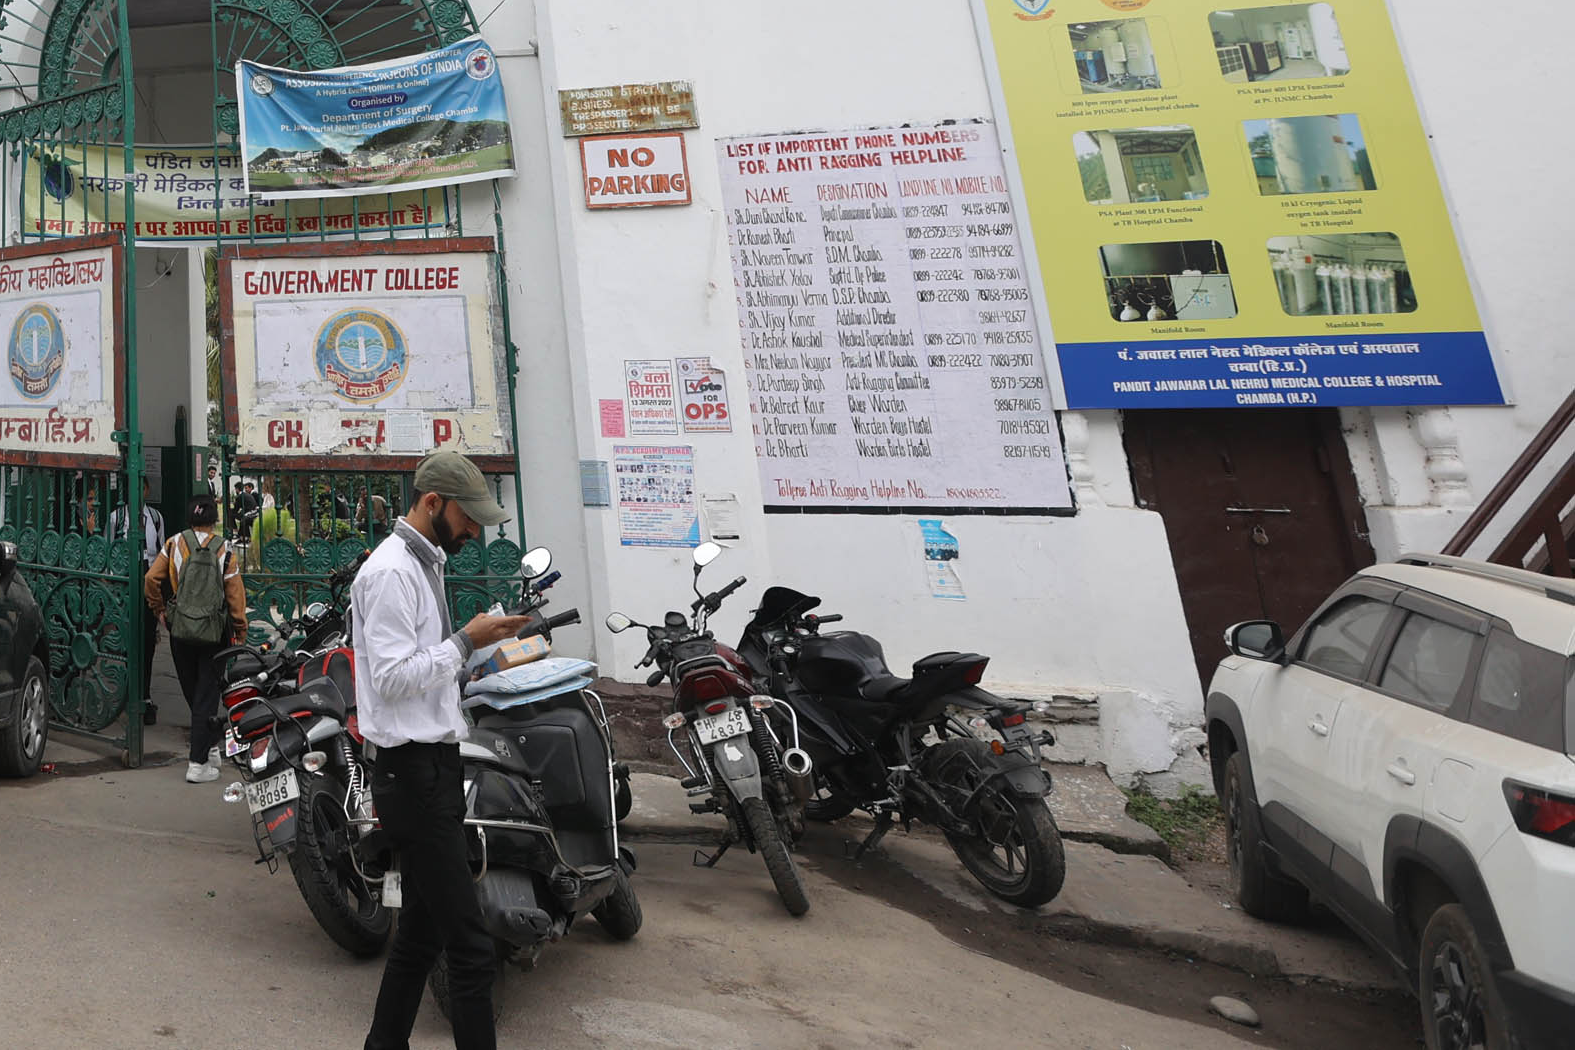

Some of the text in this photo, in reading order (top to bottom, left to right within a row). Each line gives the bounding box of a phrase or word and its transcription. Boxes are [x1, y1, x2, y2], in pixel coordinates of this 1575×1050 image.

[420, 59, 464, 75] OF INDIA
[323, 88, 347, 98] Hybrid
[347, 86, 367, 95] Event
[350, 94, 406, 108] Organised by
[321, 103, 433, 124] Department of Surgery
[335, 122, 360, 132] Nehru
[361, 120, 382, 130] Govt
[382, 116, 415, 128] Medical
[416, 112, 445, 123] College
[445, 105, 479, 117] Chamba
[640, 104, 681, 116] CAN BE
[726, 129, 980, 158] LIST OF IMPORTENT PHONE NUMBERS
[145, 152, 192, 170] पंडित
[607, 146, 655, 168] NO
[776, 146, 967, 173] ANTI RAGGING HELPLINE
[153, 173, 222, 194] मेडिकल
[588, 173, 685, 196] PARKING
[744, 175, 988, 205] NAME DESIGNATION MOBILE
[176, 195, 221, 211] जिला
[145, 221, 168, 237] पर
[173, 220, 232, 237] आपका
[27, 256, 106, 292] महाविद्यालय
[243, 266, 460, 296] GOVERNMENT COLLEGE
[761, 309, 816, 331] Vijay Kumar
[1117, 341, 1421, 361] पं. जवाहर लाल मेडिकल कॉलेज एवं अस्पताल
[643, 369, 671, 384] चलो
[1112, 374, 1443, 393] PANDIT JAWAHAR LAL NEHRU MEDICAL COLLEGE & HOSPITAL
[628, 379, 673, 399] शिमला
[703, 394, 719, 402] FOR
[1236, 391, 1318, 405] CHAMBA (H.P.)
[684, 402, 728, 421] OPS
[829, 477, 870, 501] Ragging
[703, 709, 743, 730] HP 48
[711, 721, 745, 740] 4832
[255, 773, 288, 796] HP 73
[259, 788, 289, 808] 8099
